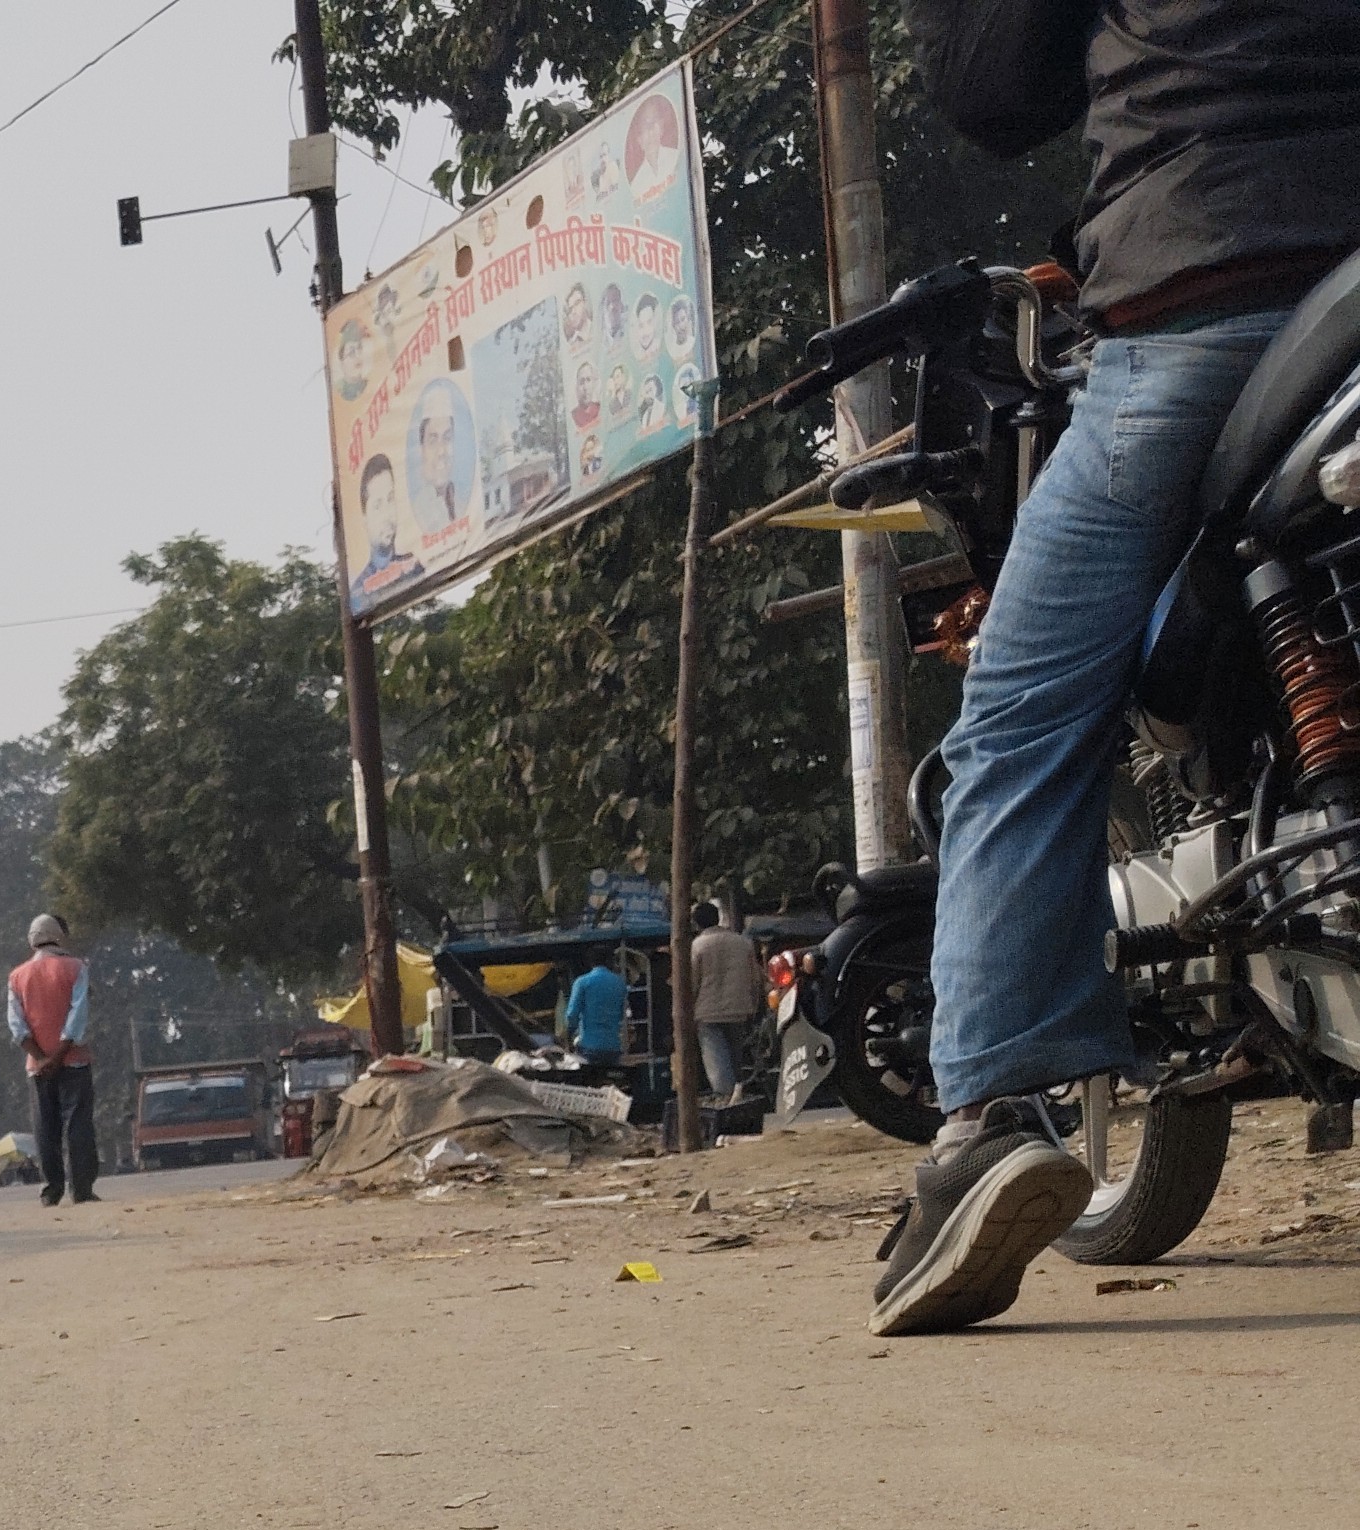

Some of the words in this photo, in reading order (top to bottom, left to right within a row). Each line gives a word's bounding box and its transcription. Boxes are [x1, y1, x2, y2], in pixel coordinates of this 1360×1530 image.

[368, 376, 390, 439] राम
[392, 301, 441, 396] जानकी
[445, 276, 476, 333] सेवा
[479, 242, 533, 305] संस्थान
[535, 213, 607, 276] पिपरियाँ
[611, 217, 683, 288] करंजहा
